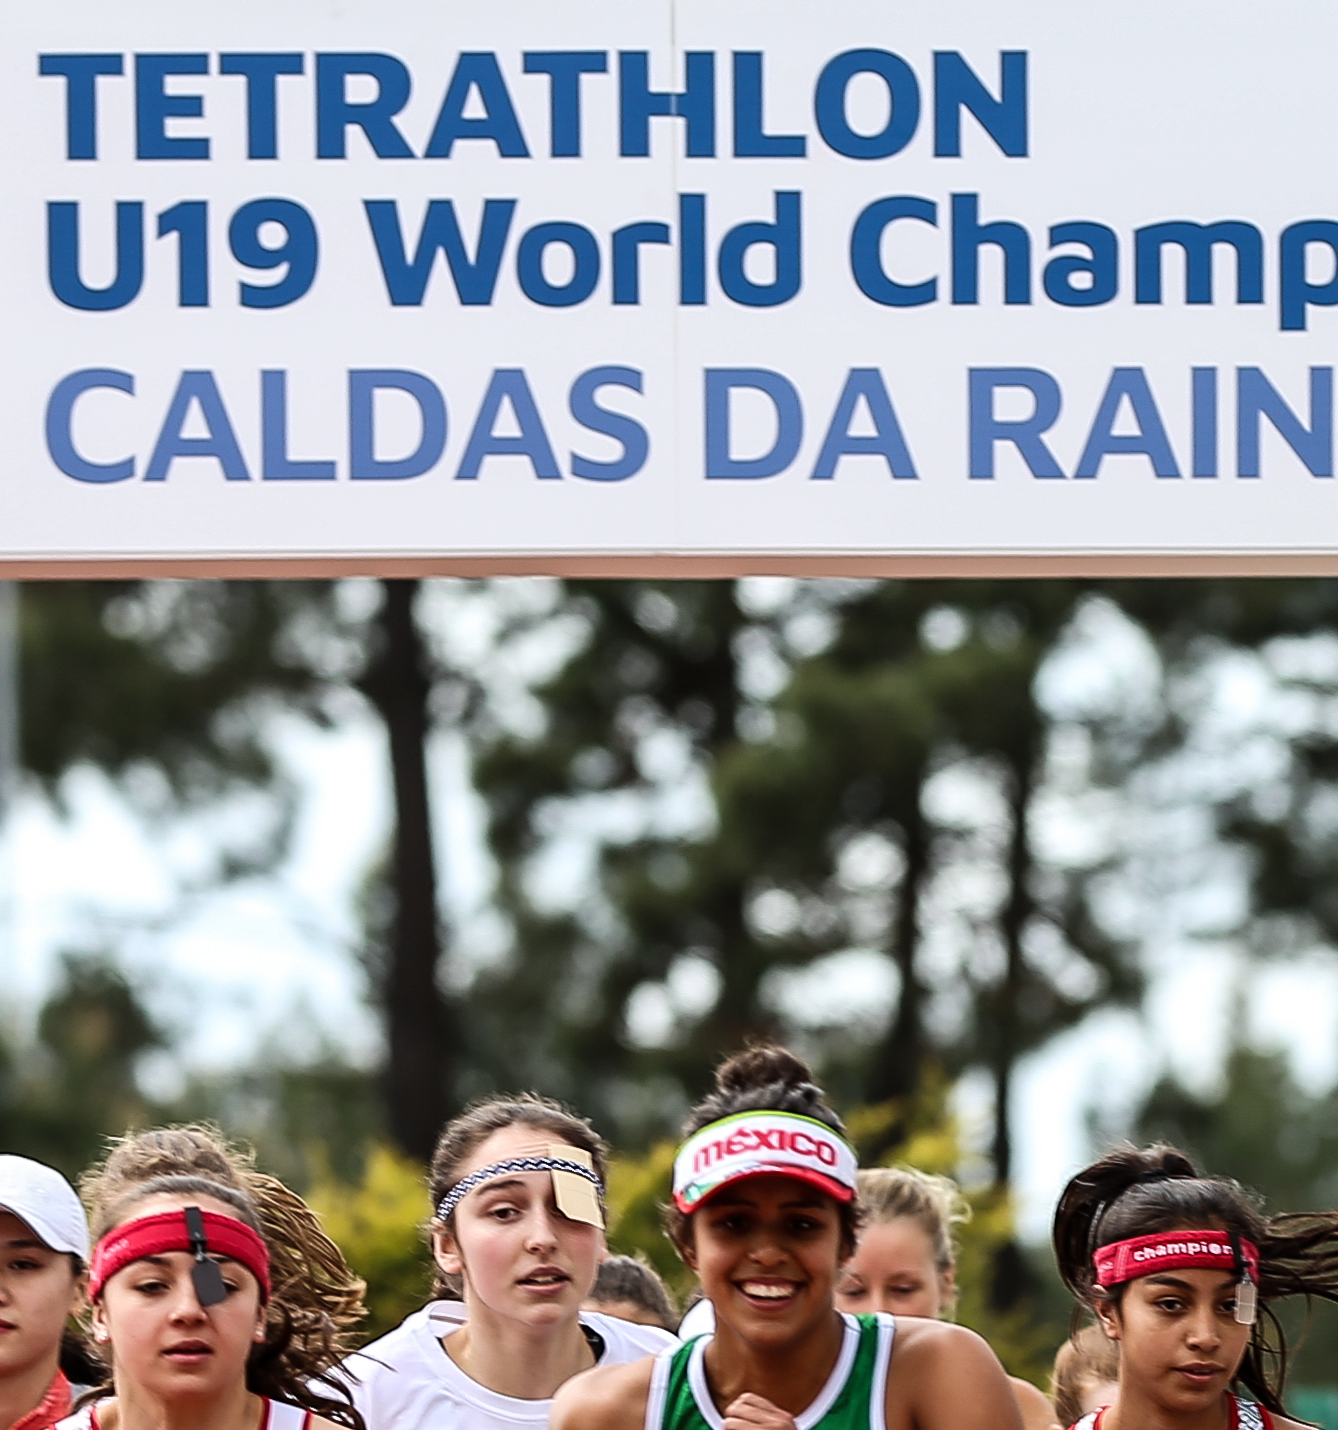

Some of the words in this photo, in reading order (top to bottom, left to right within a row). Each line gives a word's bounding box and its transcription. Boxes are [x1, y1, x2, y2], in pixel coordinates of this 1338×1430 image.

[38, 48, 1030, 161] TETRATHLON
[45, 197, 320, 313] U19
[363, 190, 803, 309] World
[44, 364, 650, 485] CALDAS
[704, 367, 920, 481] DA
